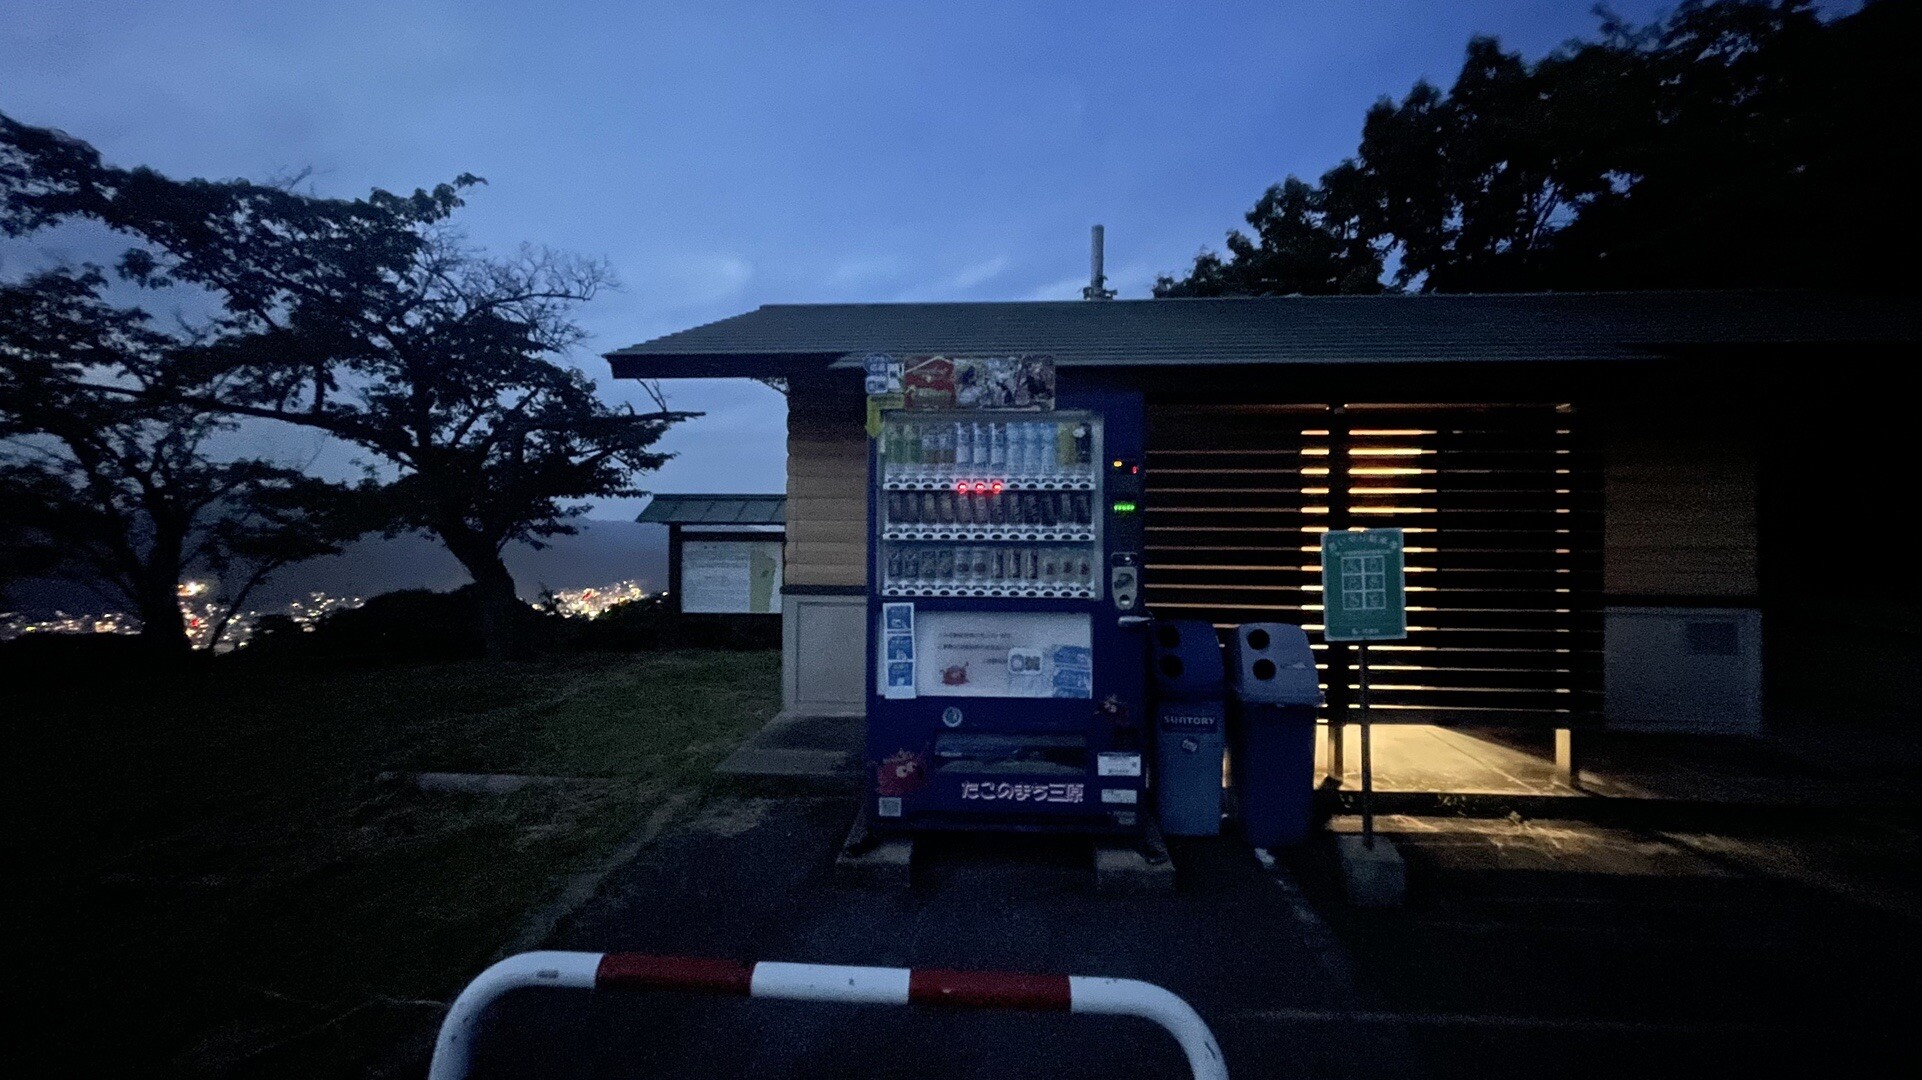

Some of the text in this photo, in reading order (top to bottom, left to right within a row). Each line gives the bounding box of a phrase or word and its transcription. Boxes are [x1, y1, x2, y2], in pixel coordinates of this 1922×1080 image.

[1164, 715, 1216, 725] SUNTORY
[962, 781, 1085, 803] たこのまち三原
